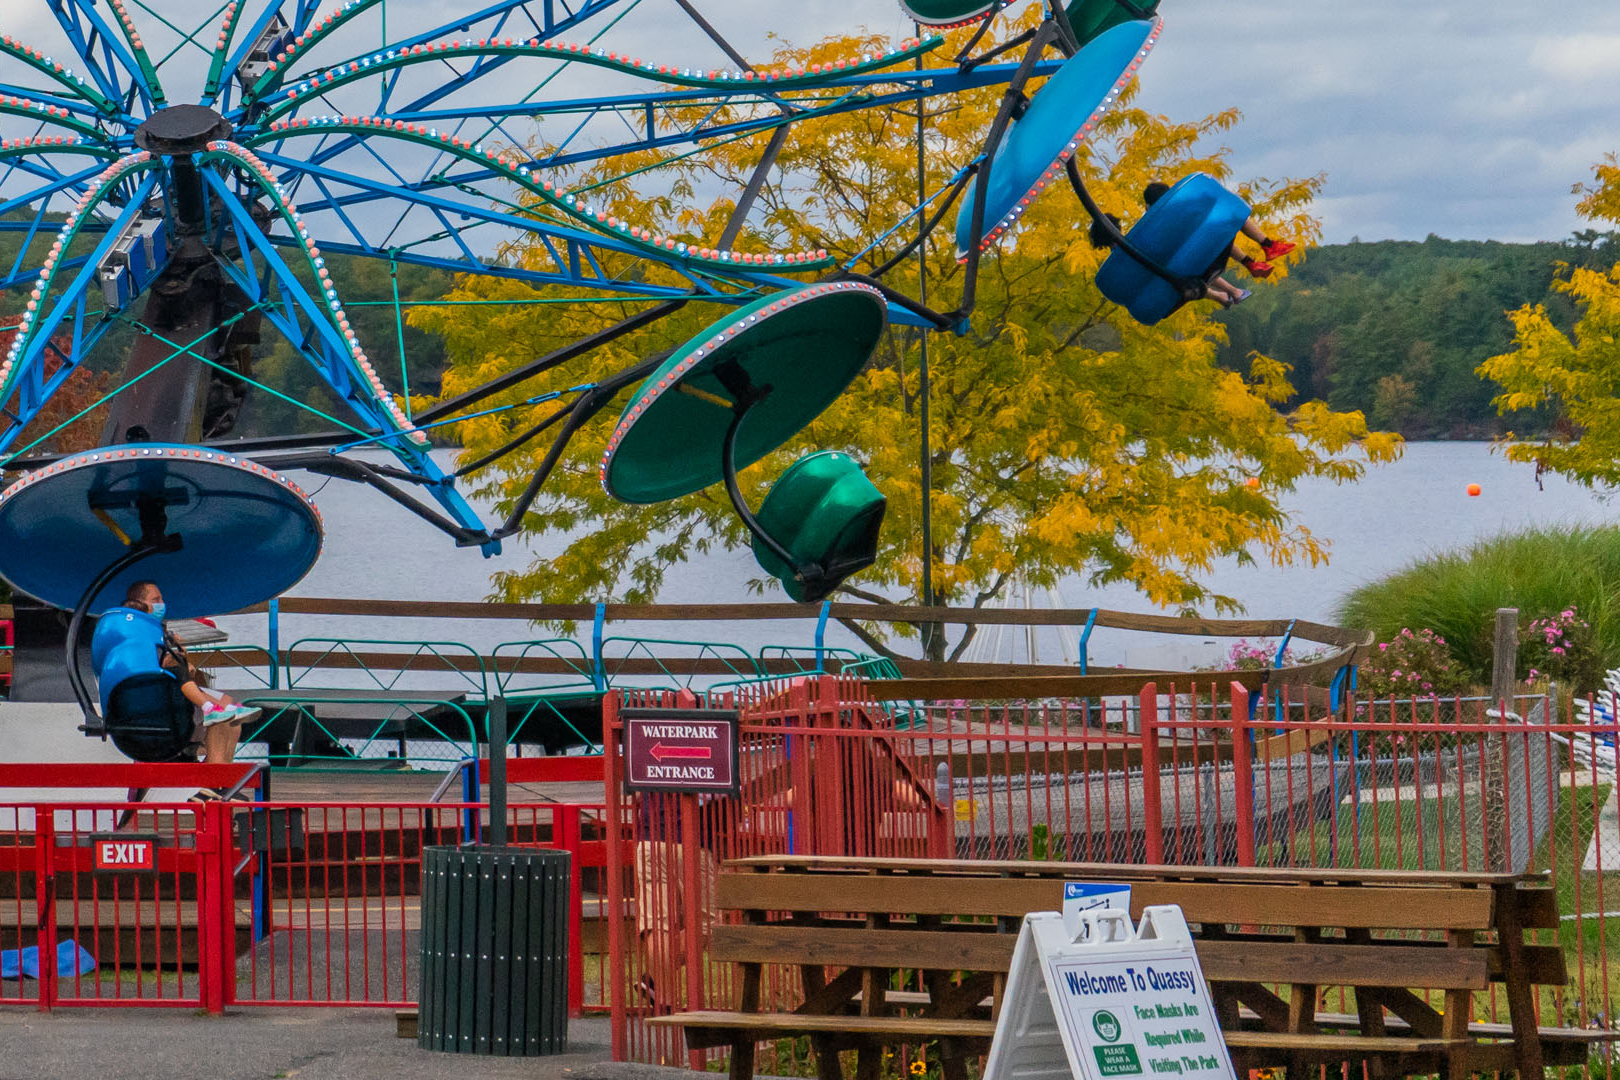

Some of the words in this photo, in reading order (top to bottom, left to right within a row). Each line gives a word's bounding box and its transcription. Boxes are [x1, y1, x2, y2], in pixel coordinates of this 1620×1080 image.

[642, 725, 718, 739] WATERPARK
[646, 766, 715, 779] ENTRANCE
[102, 843, 147, 864] EXIT
[1065, 971, 1127, 996] Welcome
[1126, 968, 1147, 992] To
[1146, 966, 1196, 995] Quassy
[1133, 1005, 1156, 1020] Face
[1155, 1003, 1183, 1018] Masks
[1183, 1002, 1199, 1016] Are
[1144, 1029, 1182, 1049] Required
[1181, 1028, 1206, 1044] While
[1103, 1047, 1126, 1055] PLEASE
[1105, 1056, 1124, 1064] WEAR
[1148, 1057, 1183, 1075] Visiting
[1181, 1056, 1199, 1071] The
[1198, 1054, 1219, 1070] Park
[1103, 1065, 1119, 1073] FACE
[1119, 1064, 1138, 1072] MASK
